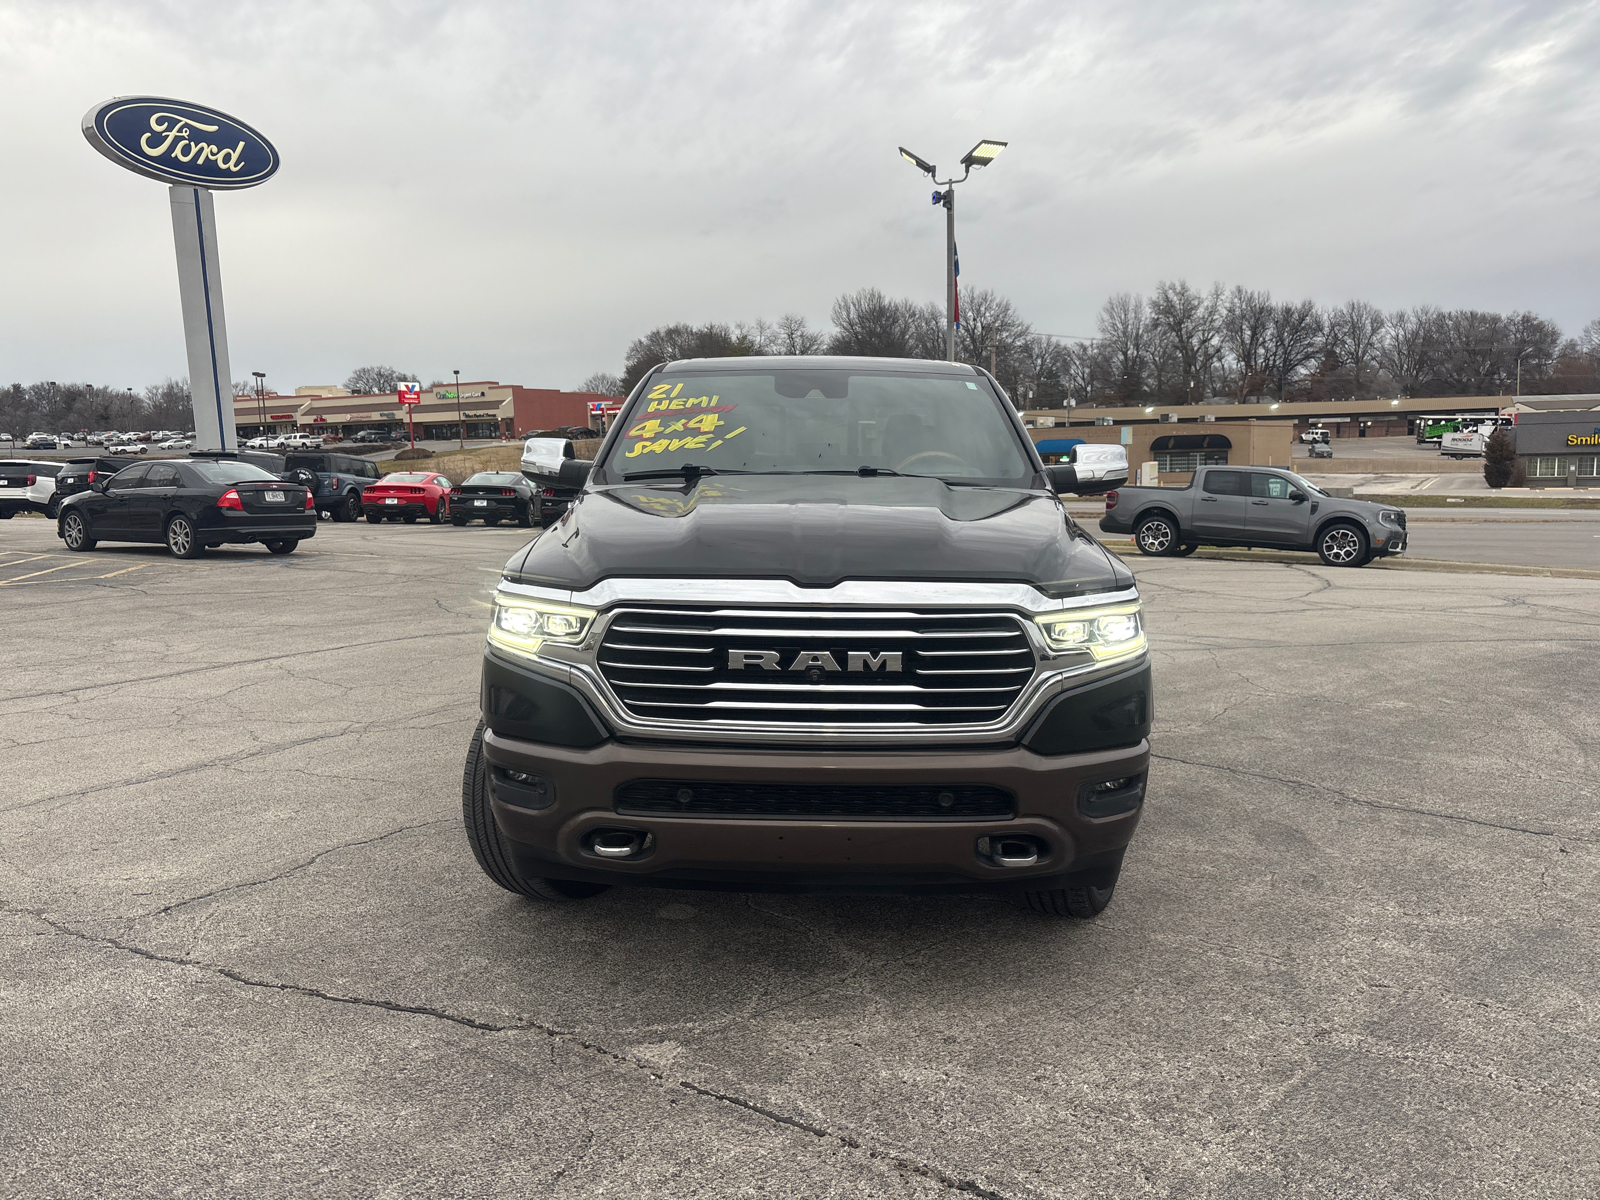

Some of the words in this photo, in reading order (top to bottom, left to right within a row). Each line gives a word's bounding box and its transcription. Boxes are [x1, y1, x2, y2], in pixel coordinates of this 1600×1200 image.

[140, 112, 247, 172] Ford
[647, 383, 684, 399] 21
[647, 395, 720, 412] HEMI
[1567, 433, 1600, 446] Smil
[728, 649, 902, 672] RAM
